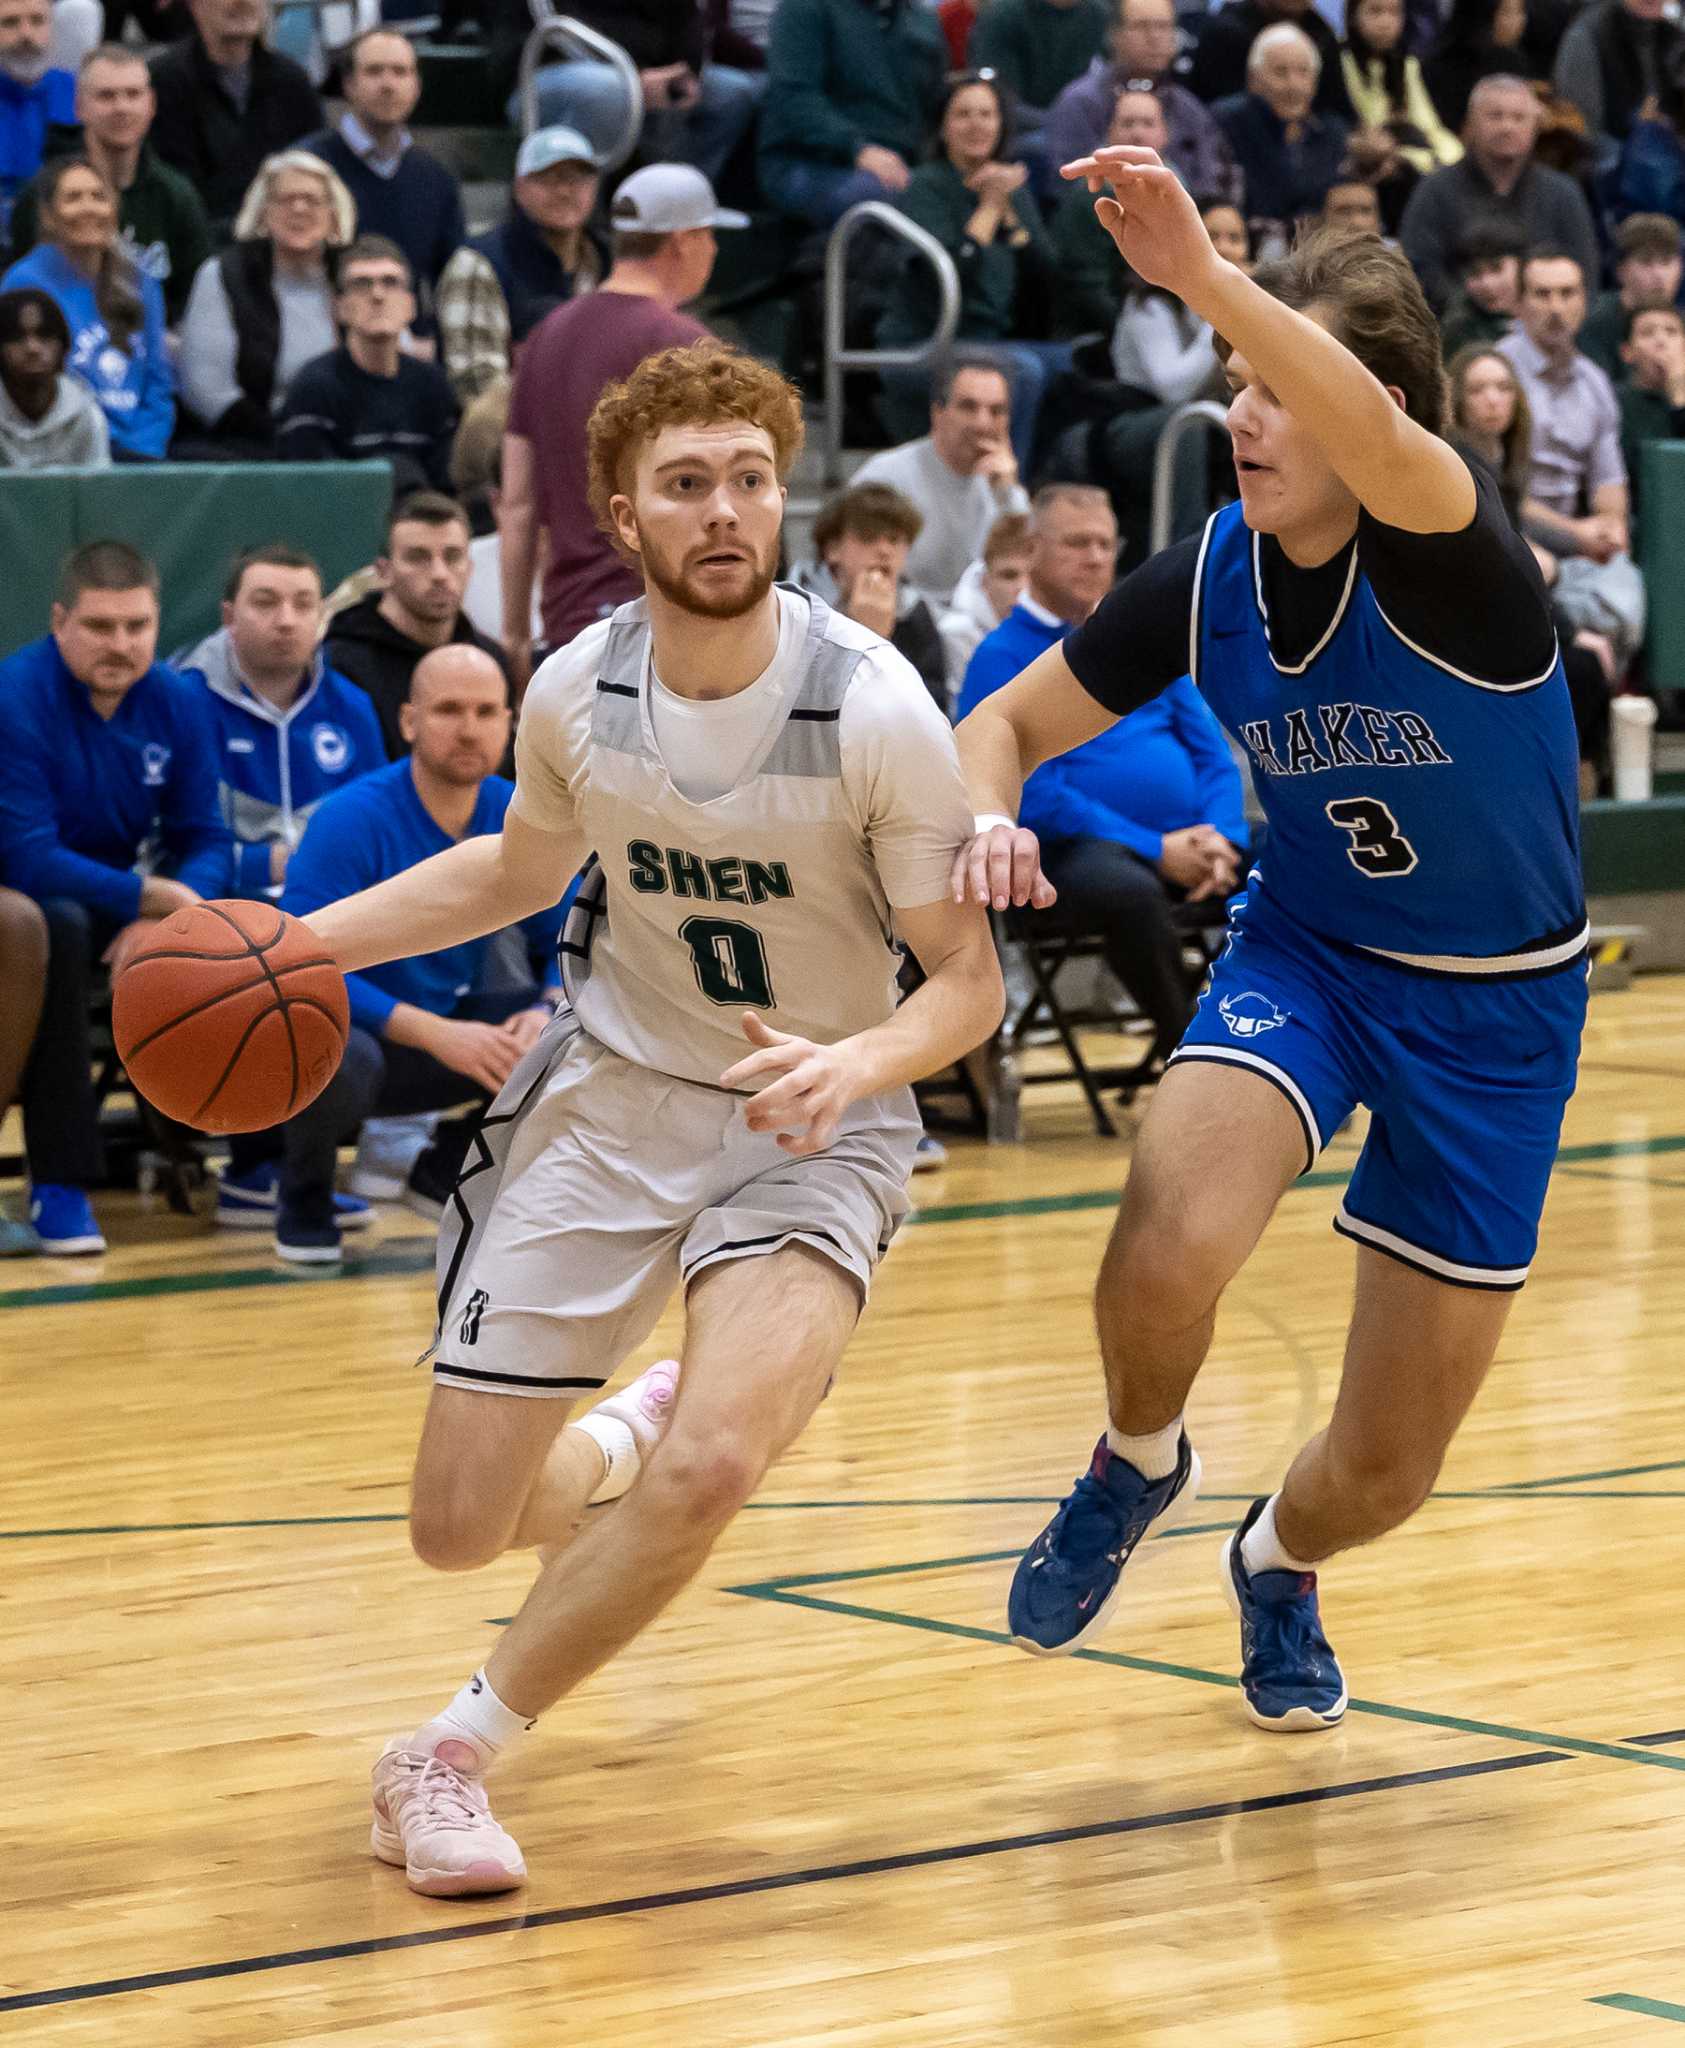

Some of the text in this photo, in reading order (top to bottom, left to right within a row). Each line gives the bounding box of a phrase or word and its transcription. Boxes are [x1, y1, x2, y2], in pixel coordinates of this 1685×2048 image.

[1239, 703, 1453, 775] HAKER
[627, 839, 795, 906] SHEN
[1325, 797, 1419, 879] 3
[678, 914, 777, 1010] 0
